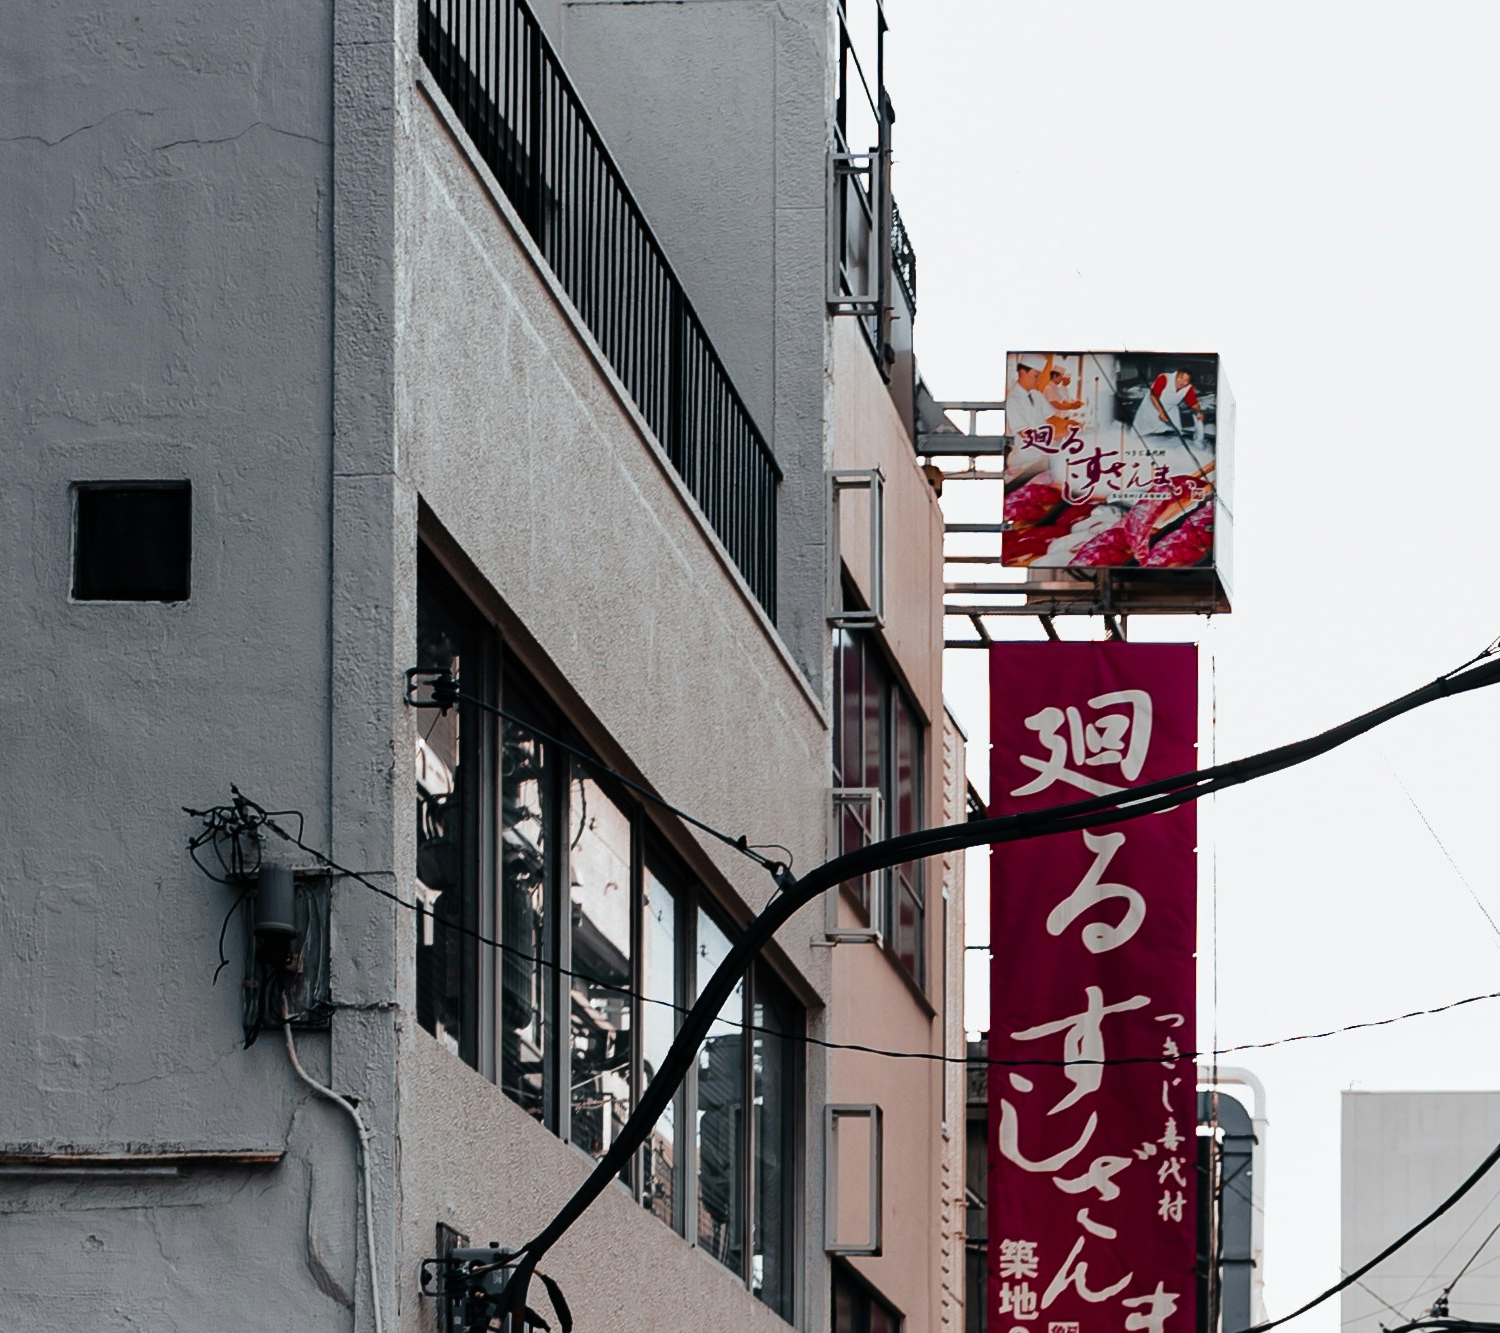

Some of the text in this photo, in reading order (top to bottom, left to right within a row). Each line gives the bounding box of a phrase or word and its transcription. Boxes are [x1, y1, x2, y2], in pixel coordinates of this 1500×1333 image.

[1155, 1012, 1188, 1223] つきじ喜代村
